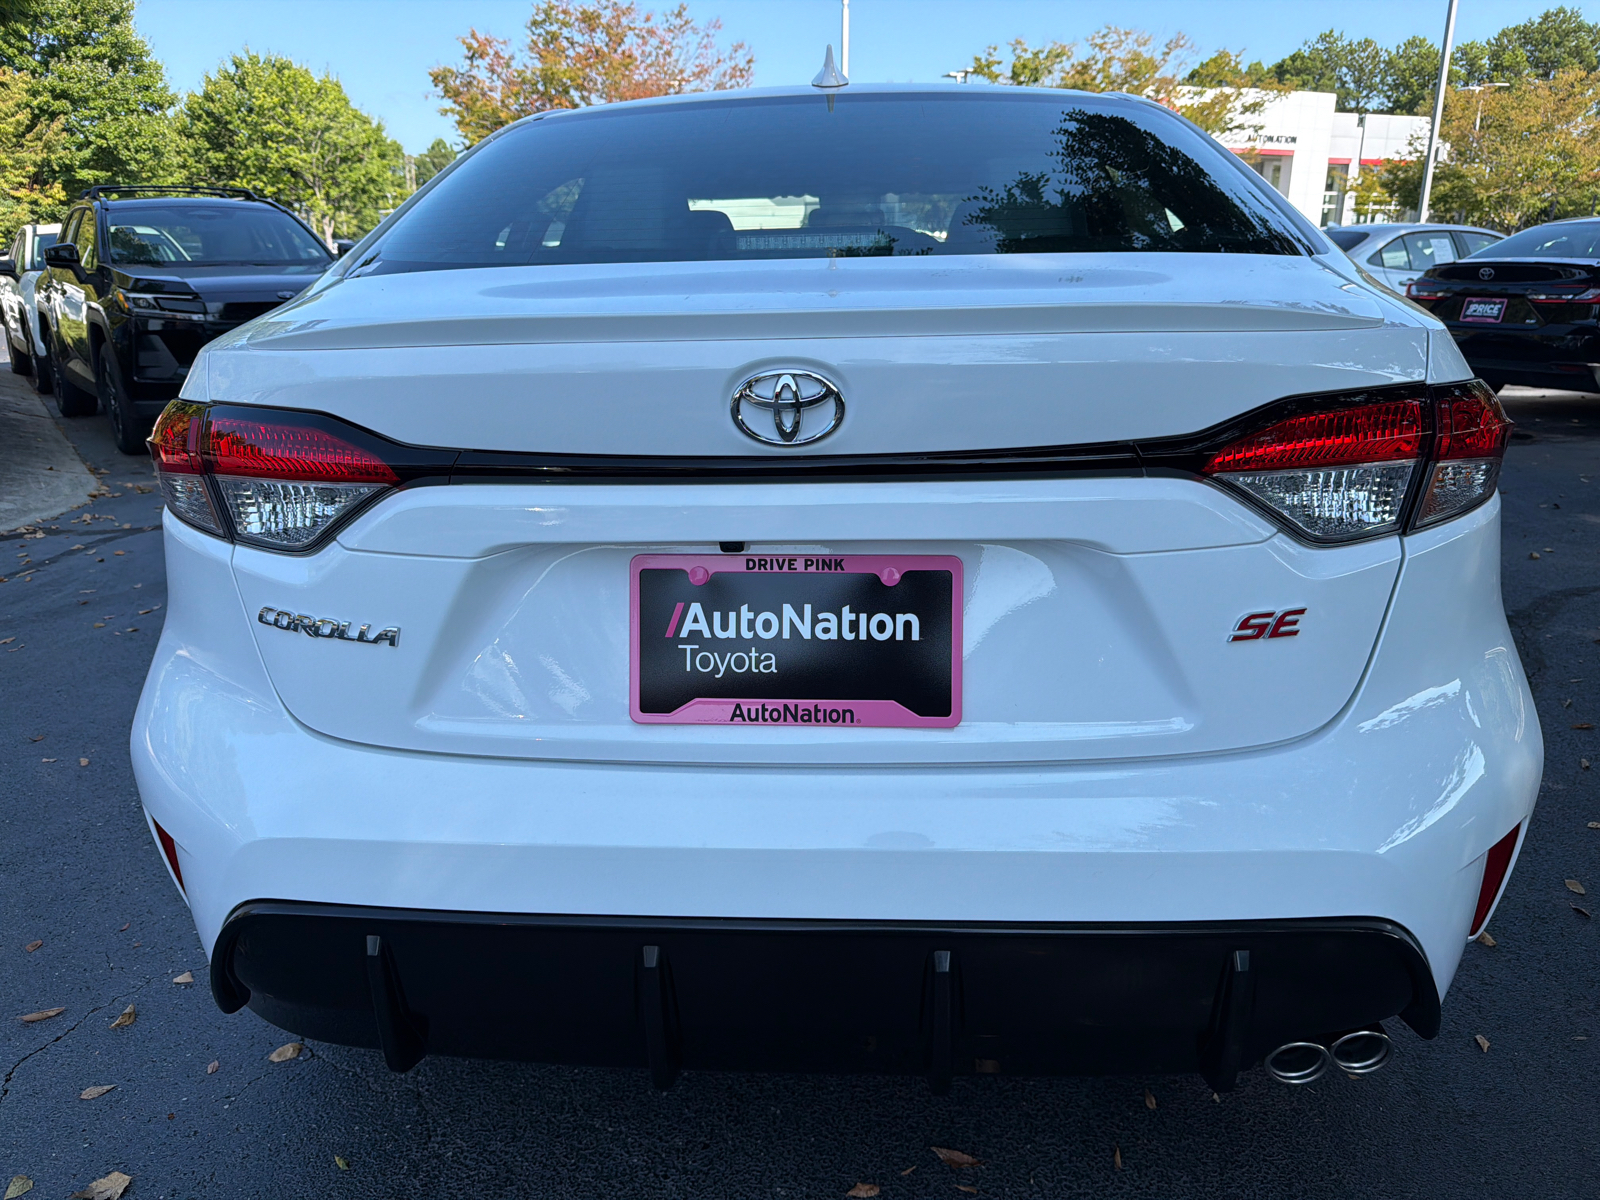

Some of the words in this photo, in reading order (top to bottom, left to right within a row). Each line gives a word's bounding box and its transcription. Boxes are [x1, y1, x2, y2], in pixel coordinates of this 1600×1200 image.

[745, 558, 798, 571] DRIVE
[803, 559, 846, 572] PINK
[257, 606, 401, 647] COROLLA
[678, 602, 920, 641] AutoNation
[1226, 606, 1307, 642] SE
[677, 644, 778, 678] Toyota
[729, 703, 855, 724] AutoNation
